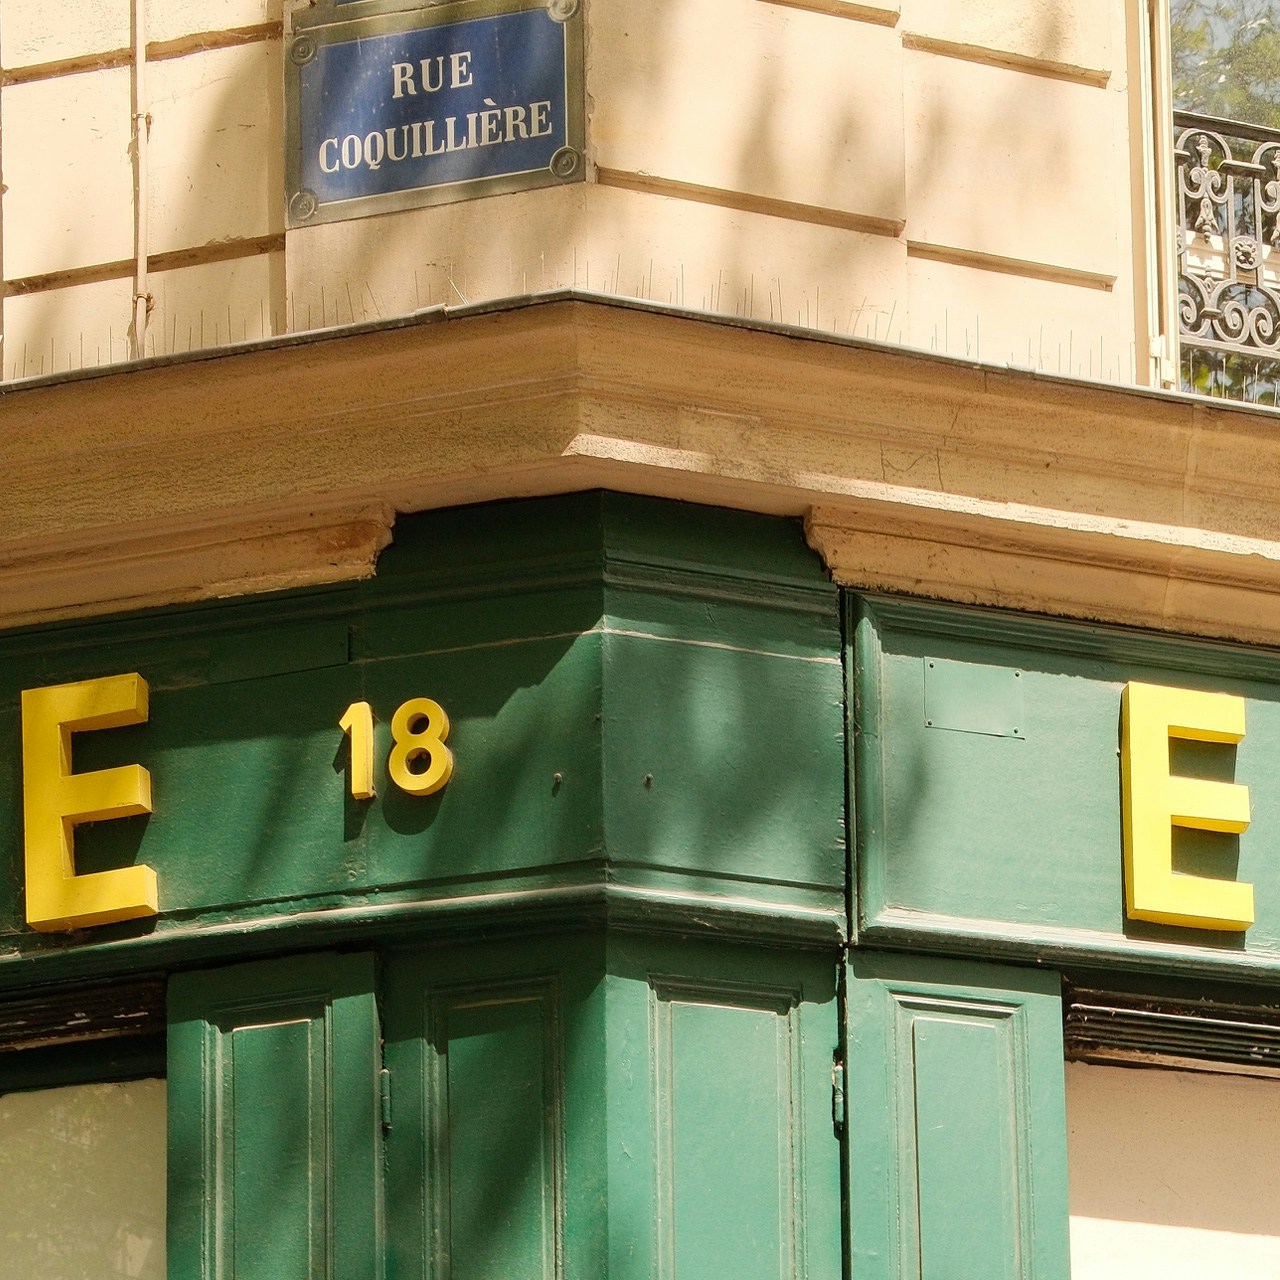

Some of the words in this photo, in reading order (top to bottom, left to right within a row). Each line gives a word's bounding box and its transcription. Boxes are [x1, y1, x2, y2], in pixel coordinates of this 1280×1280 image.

[392, 51, 473, 99] RUE
[319, 97, 553, 174] COQUILLIÈRE
[339, 697, 454, 800] 18
